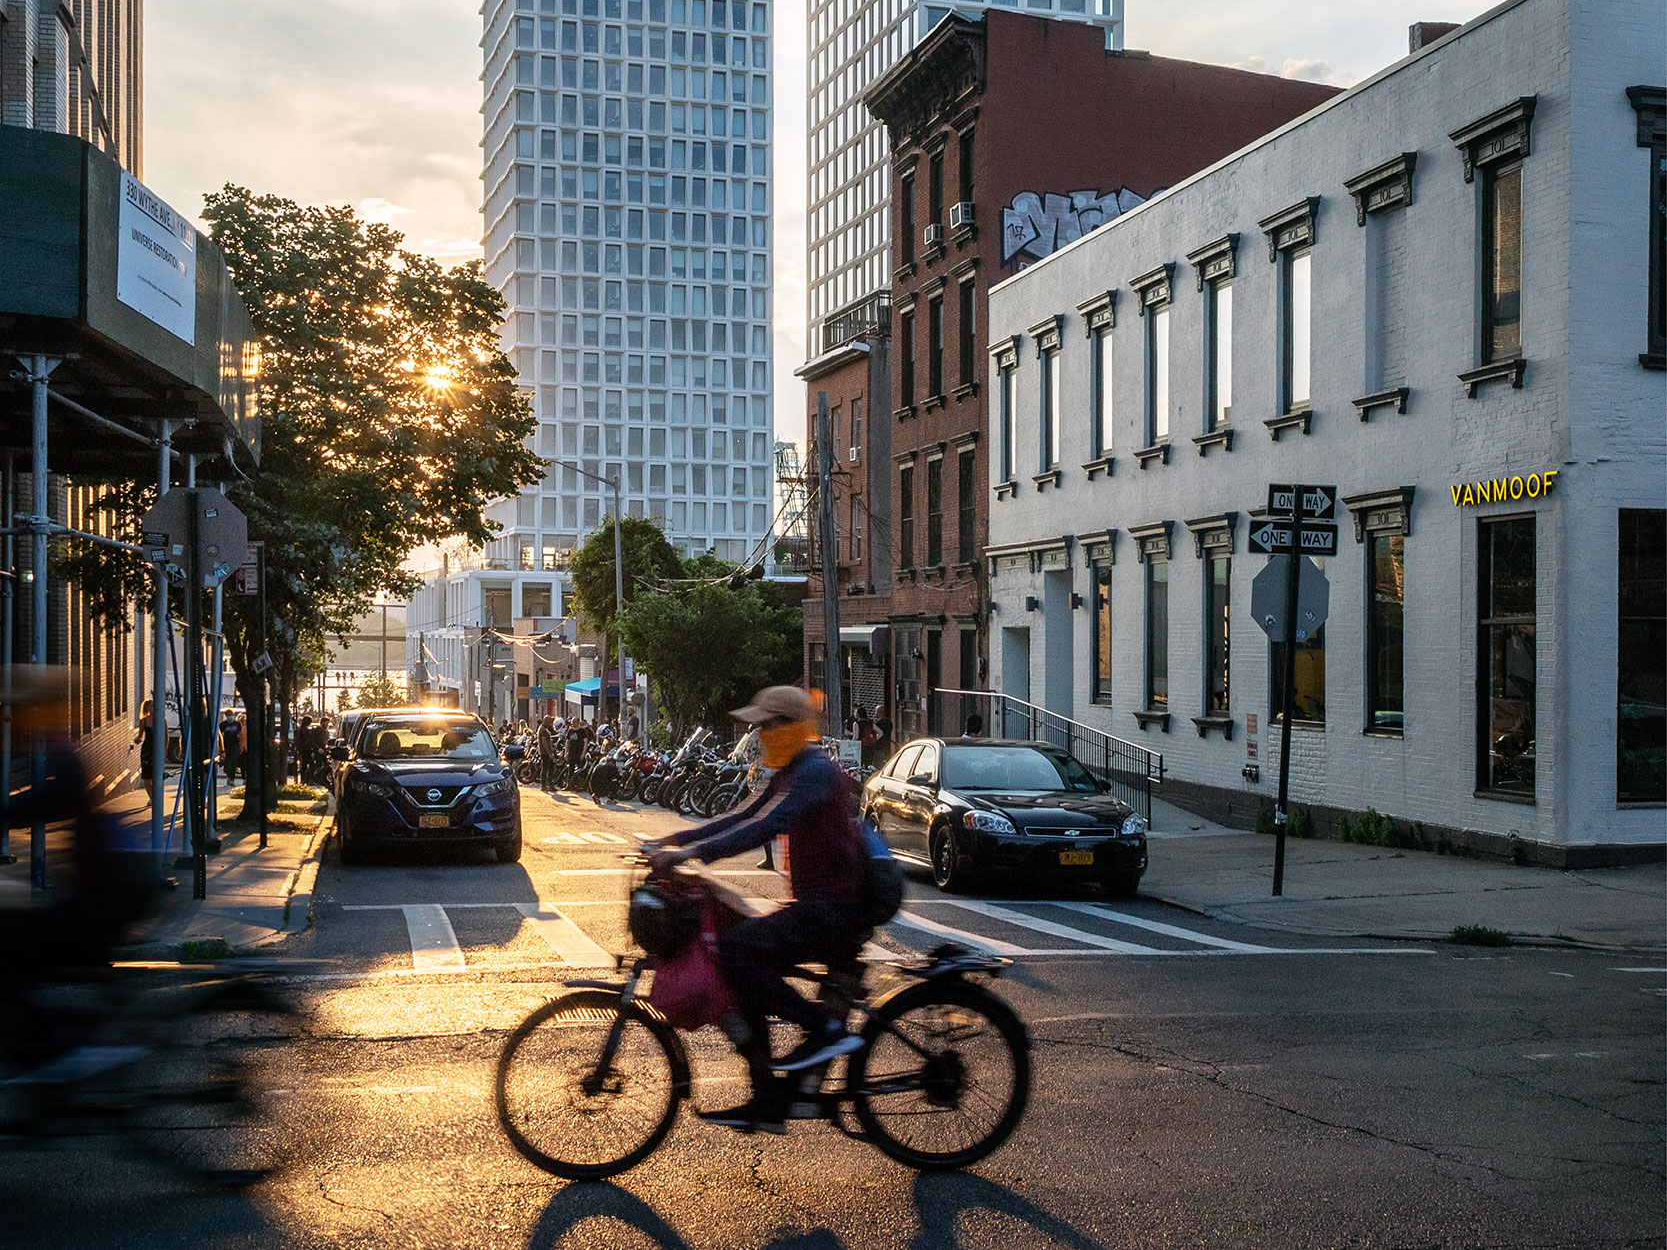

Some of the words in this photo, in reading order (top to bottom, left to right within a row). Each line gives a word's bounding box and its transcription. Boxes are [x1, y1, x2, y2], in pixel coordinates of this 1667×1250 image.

[126, 179, 138, 202] 330
[138, 187, 159, 218] WYTHE
[131, 227, 153, 252] UNIVERSE
[1451, 470, 1558, 507] VANMOOF
[1278, 494, 1294, 508] ON
[1305, 495, 1325, 509] WAY
[1260, 530, 1287, 545] ONE
[1302, 532, 1330, 546] WAY
